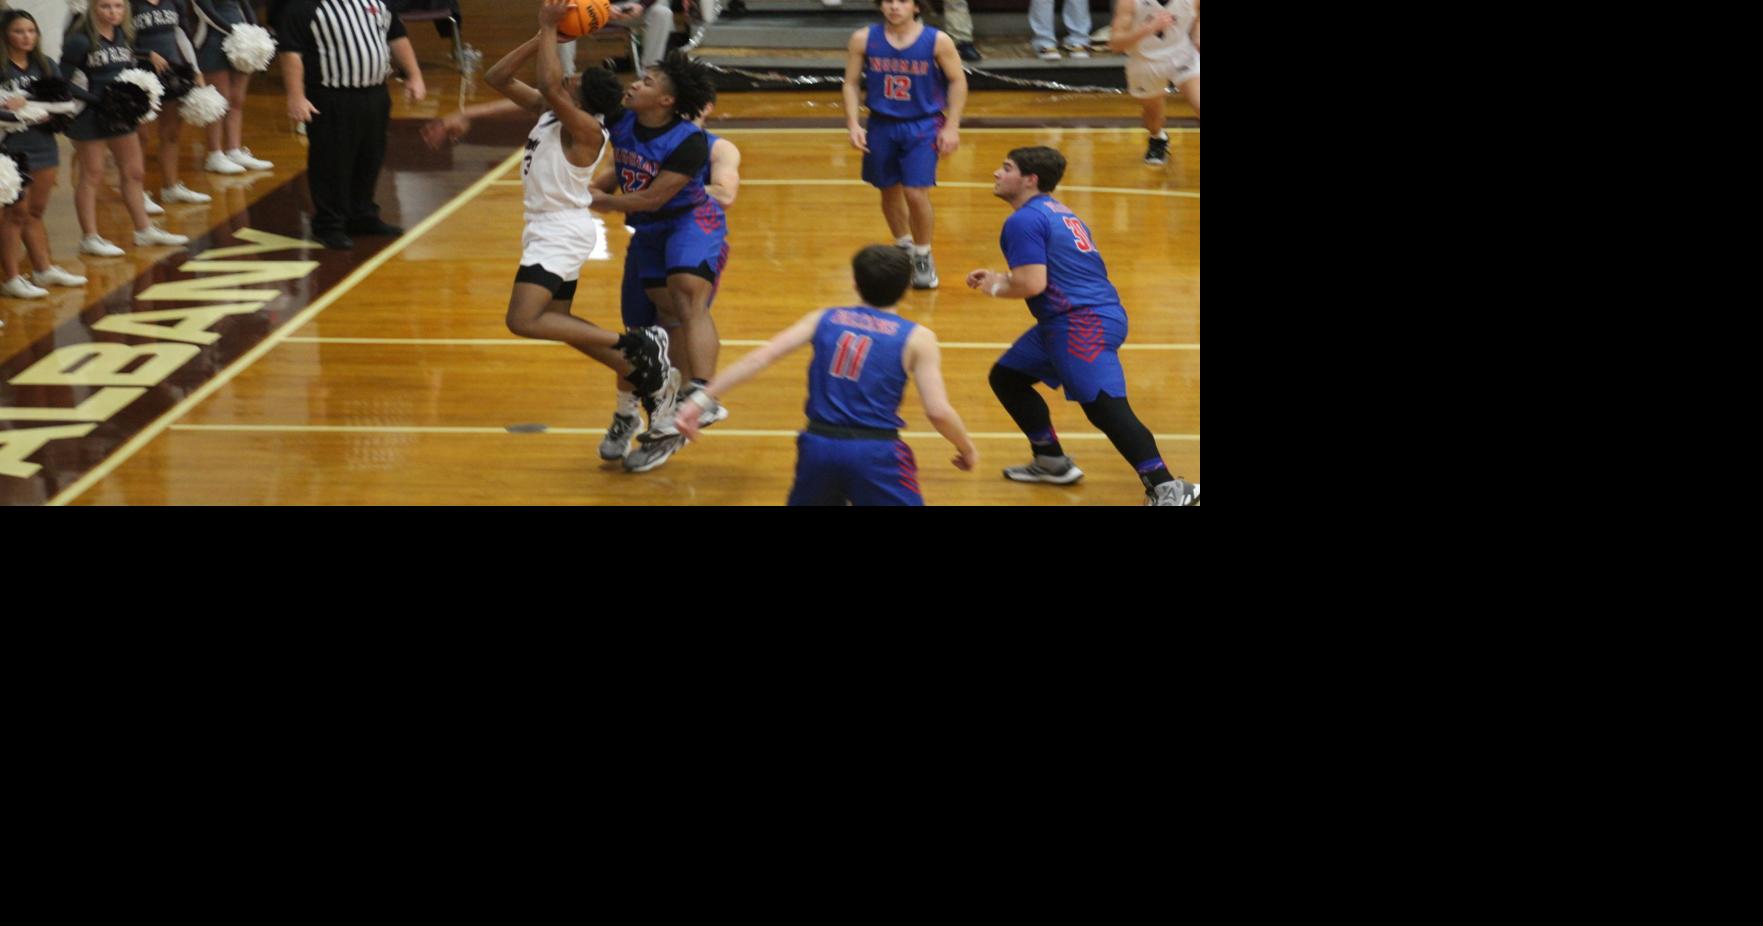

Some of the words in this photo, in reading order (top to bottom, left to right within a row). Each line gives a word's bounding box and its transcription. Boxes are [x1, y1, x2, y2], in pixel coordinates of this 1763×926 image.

[884, 74, 911, 100] 12
[622, 168, 651, 192] 22
[0, 227, 324, 478] ALBANY
[829, 330, 873, 382] 11
